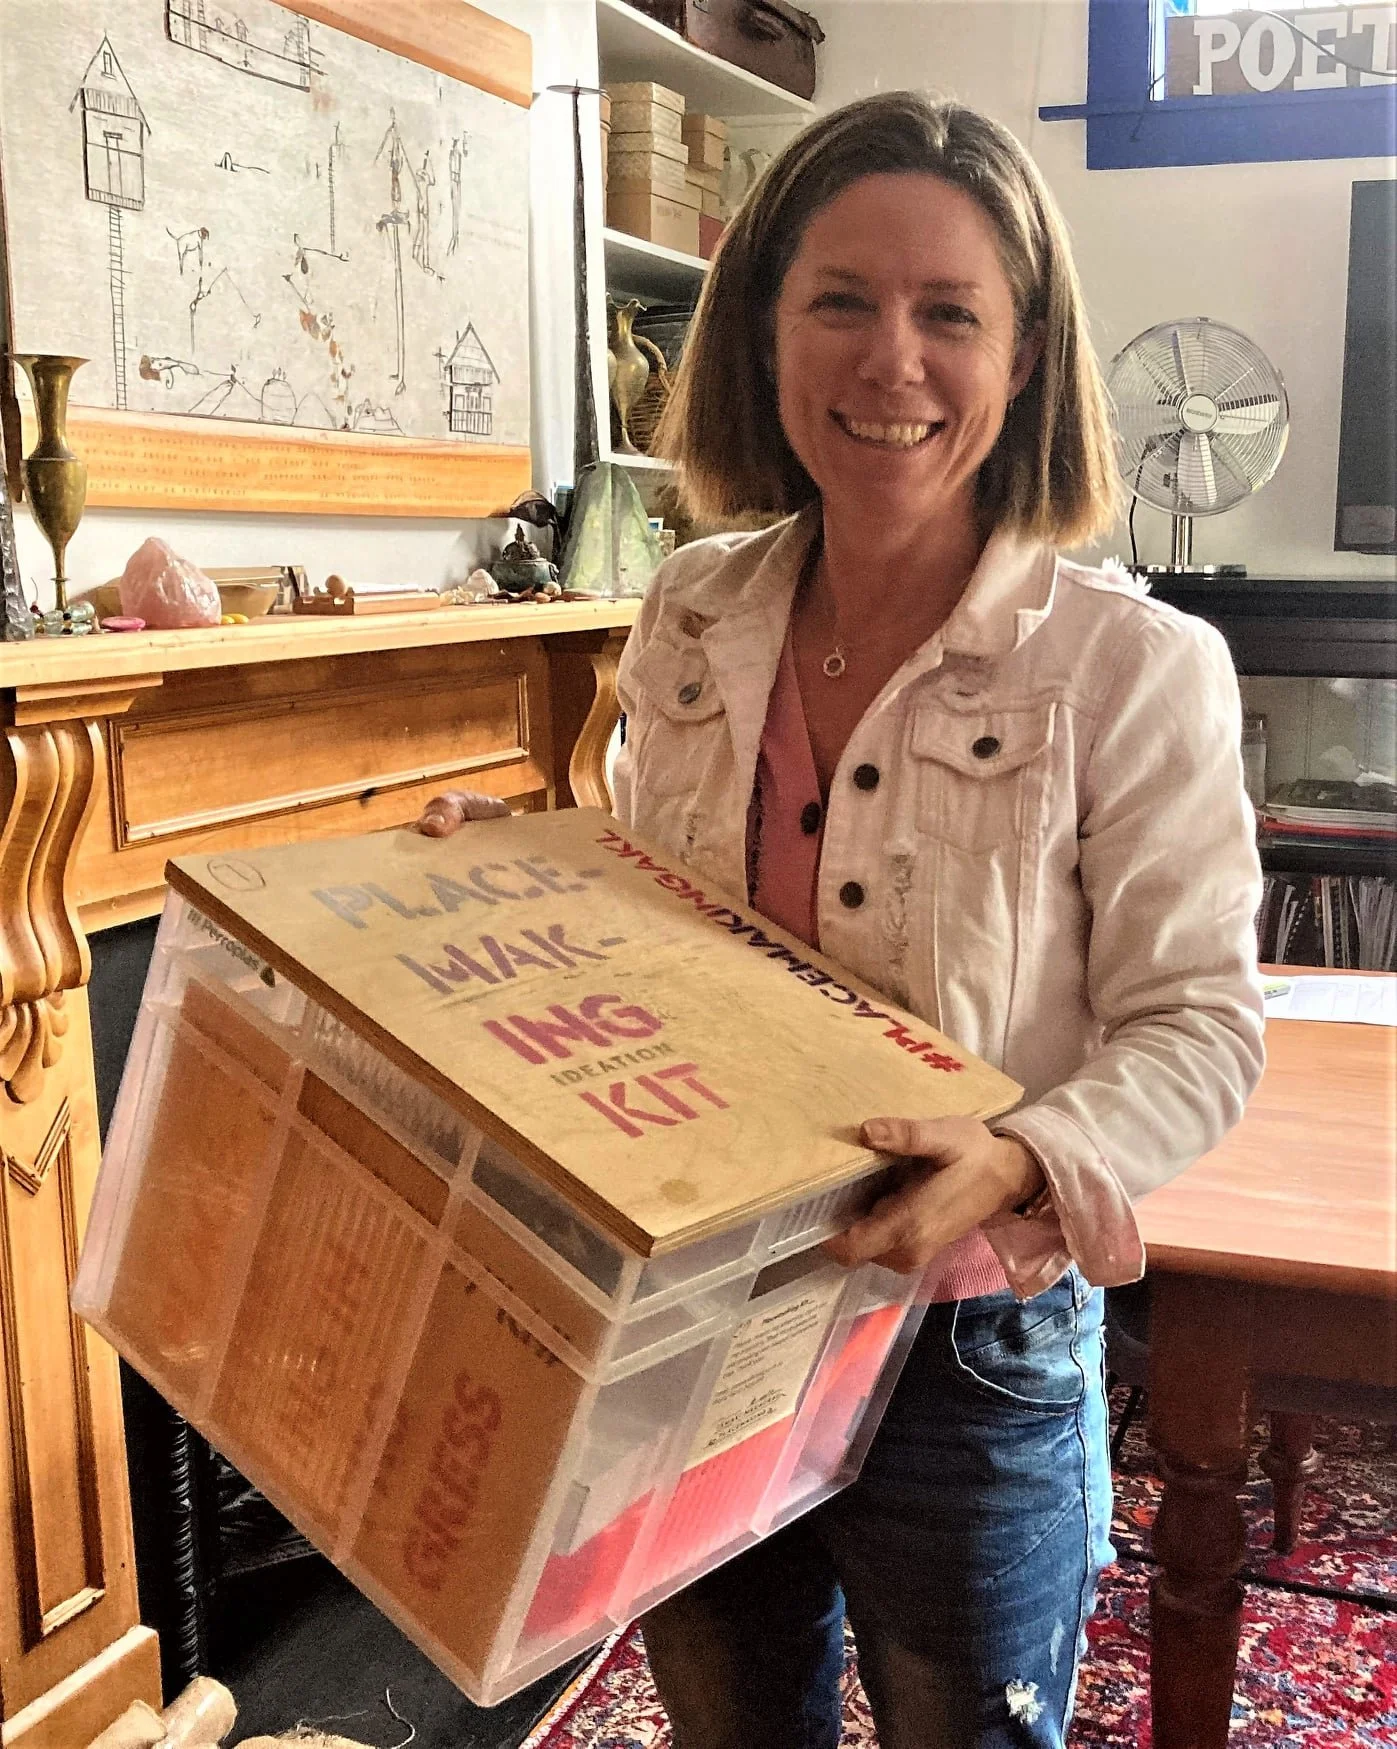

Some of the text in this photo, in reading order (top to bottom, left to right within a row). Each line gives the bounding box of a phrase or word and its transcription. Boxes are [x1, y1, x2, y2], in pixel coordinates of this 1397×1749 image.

[1192, 8, 1397, 96] POET
[311, 855, 603, 929] PLACE-
[395, 924, 627, 994] MAK-
[596, 828, 964, 1072] #PLACEMAKINGAKL
[483, 994, 665, 1065] ING
[550, 1041, 675, 1087] IDEATION
[579, 1062, 731, 1139] KIT
